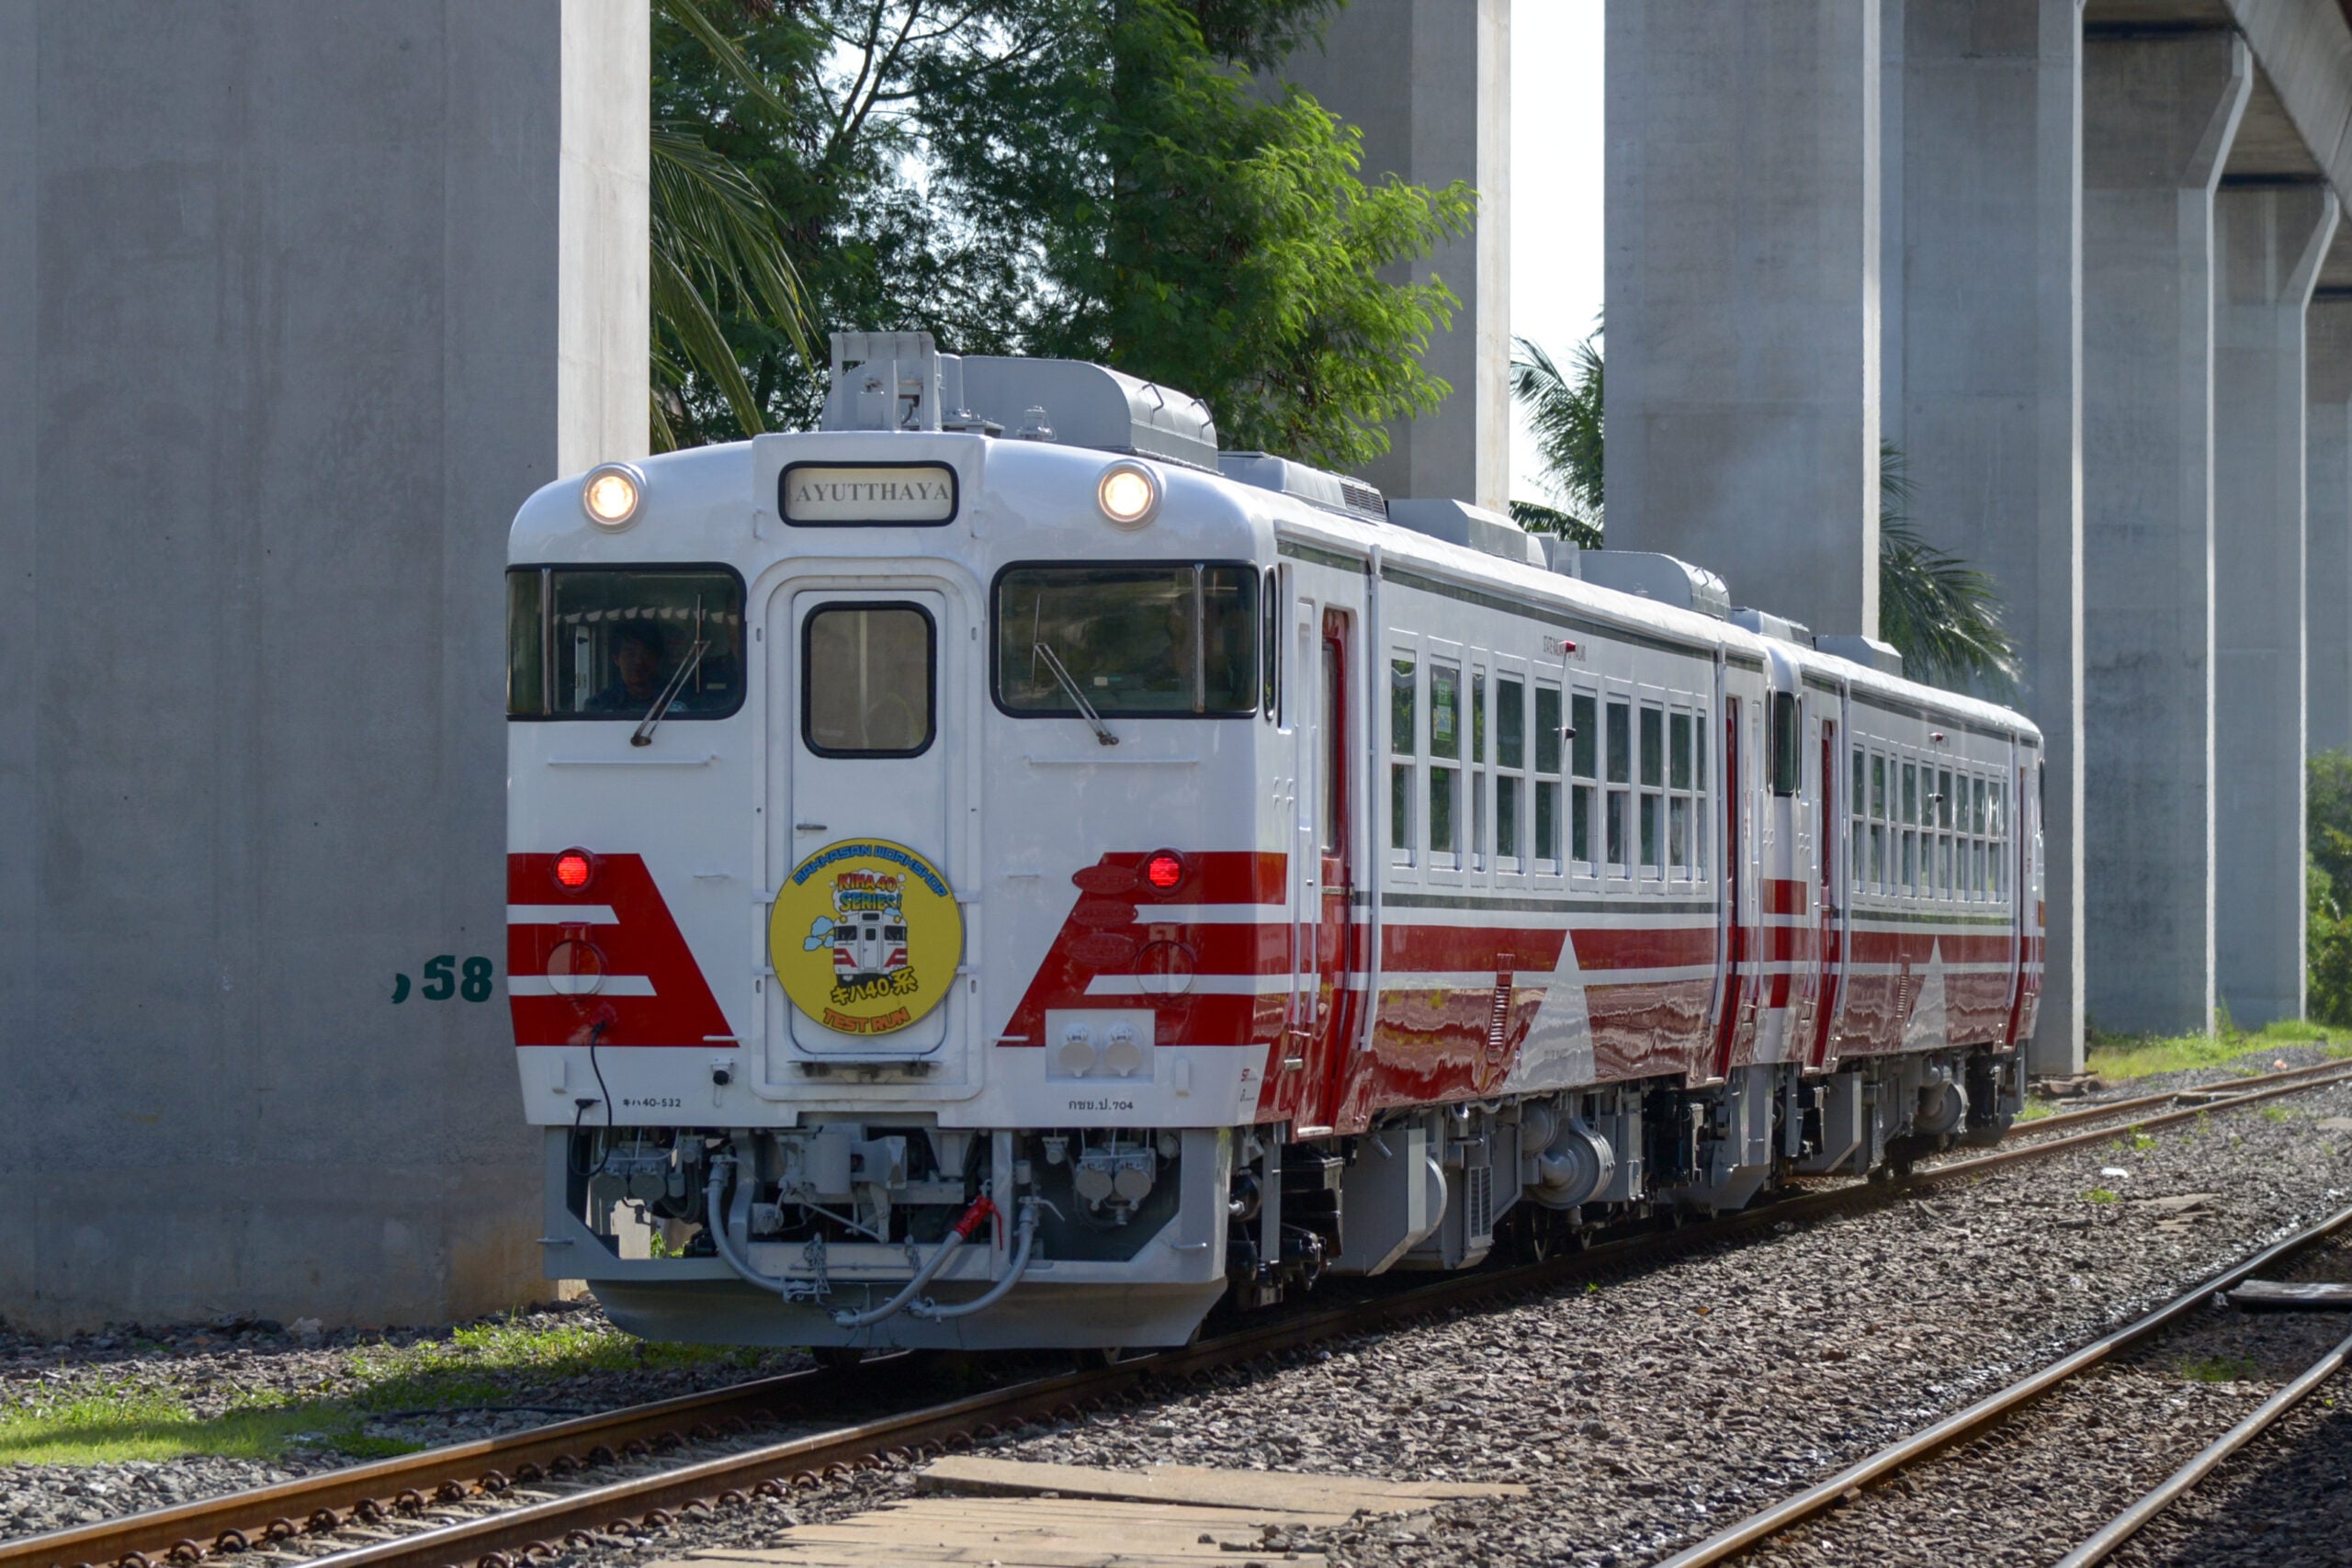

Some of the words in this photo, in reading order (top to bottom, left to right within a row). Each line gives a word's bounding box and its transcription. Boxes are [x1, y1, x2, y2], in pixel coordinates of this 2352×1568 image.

[796, 482, 950, 502] AYUTTHAYA
[793, 844, 873, 886] MAKKASAN
[874, 845, 948, 897] WORKSHOP
[838, 872, 876, 892] KIHA
[875, 875, 898, 892] 40
[831, 965, 919, 1006] キハ40系
[823, 1007, 869, 1032] TEST
[870, 1006, 911, 1032] RUN
